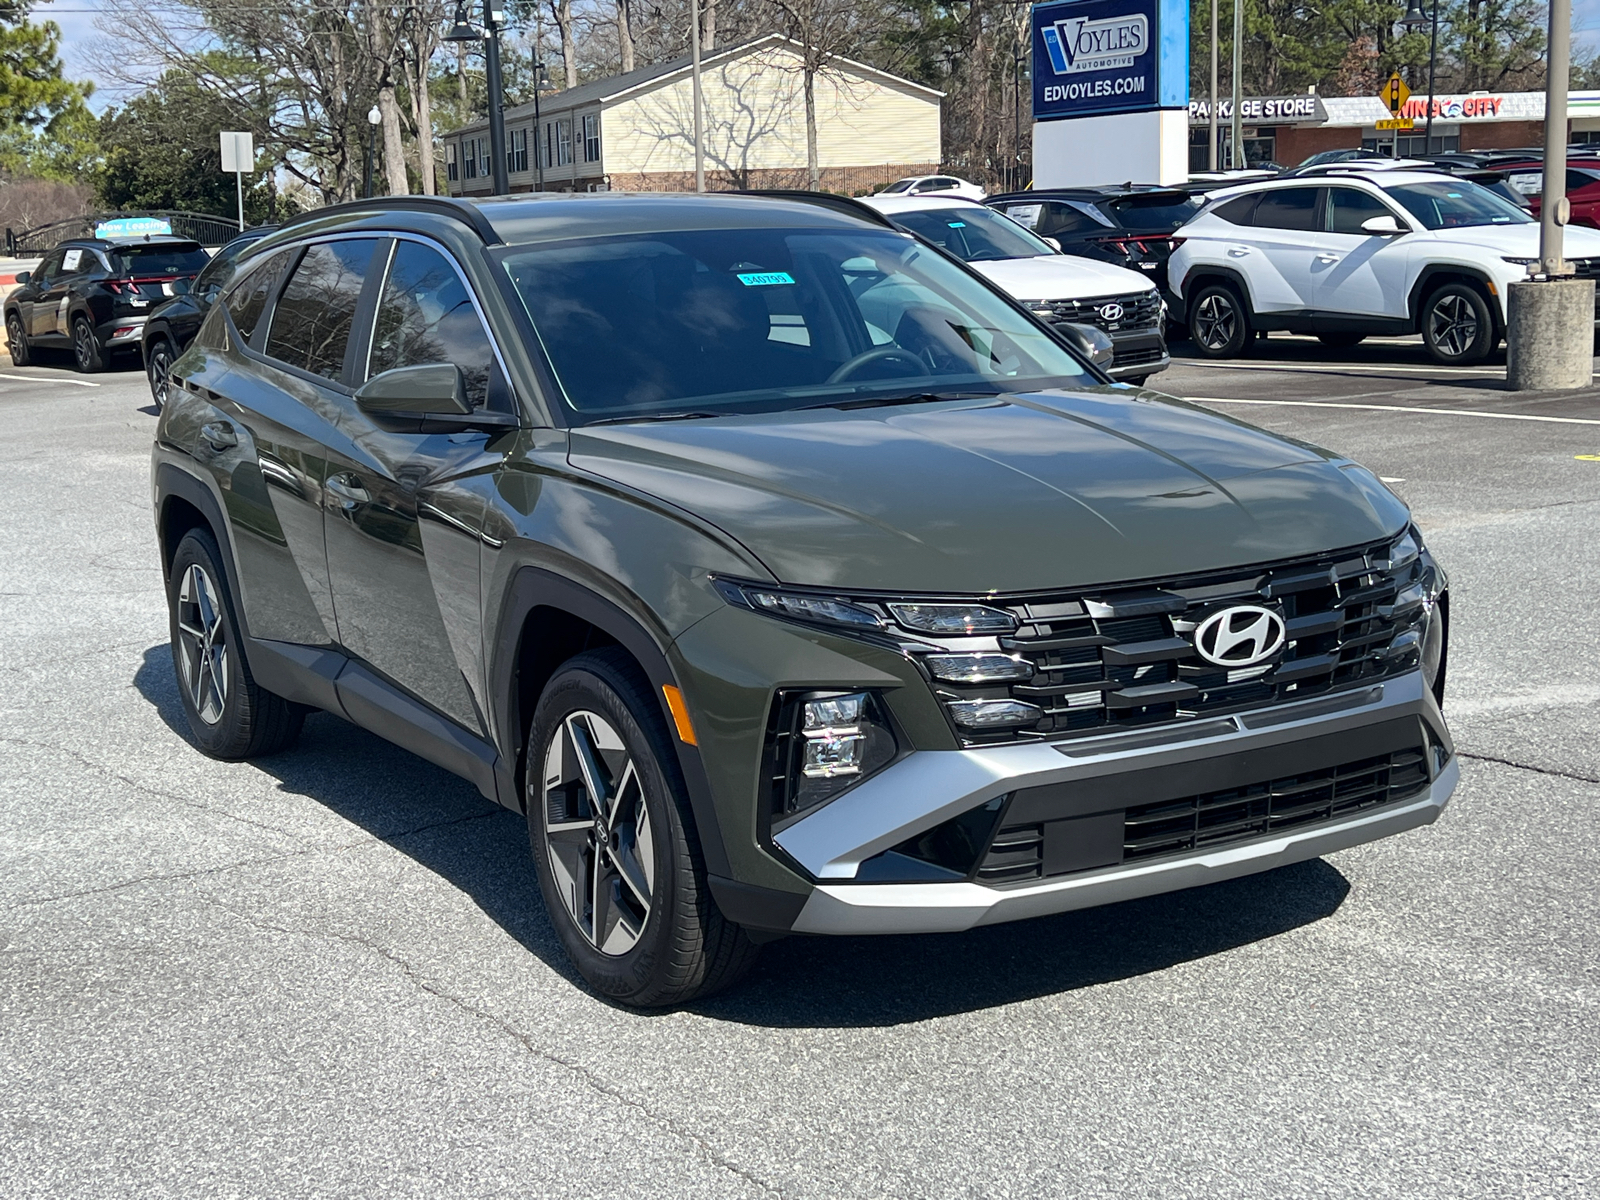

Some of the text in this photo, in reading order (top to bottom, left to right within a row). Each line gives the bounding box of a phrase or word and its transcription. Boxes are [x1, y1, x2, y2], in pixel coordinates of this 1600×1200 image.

[1048, 20, 1141, 66] ED VOYLES
[1075, 57, 1132, 70] AUTOMOTIVE
[1044, 76, 1145, 102] EDVOYLES.COM
[1264, 98, 1315, 115] STORE
[1463, 97, 1502, 117] CITY
[1387, 119, 1400, 129] Park
[98, 221, 168, 231] Now Leasing
[744, 275, 787, 284] 340799
